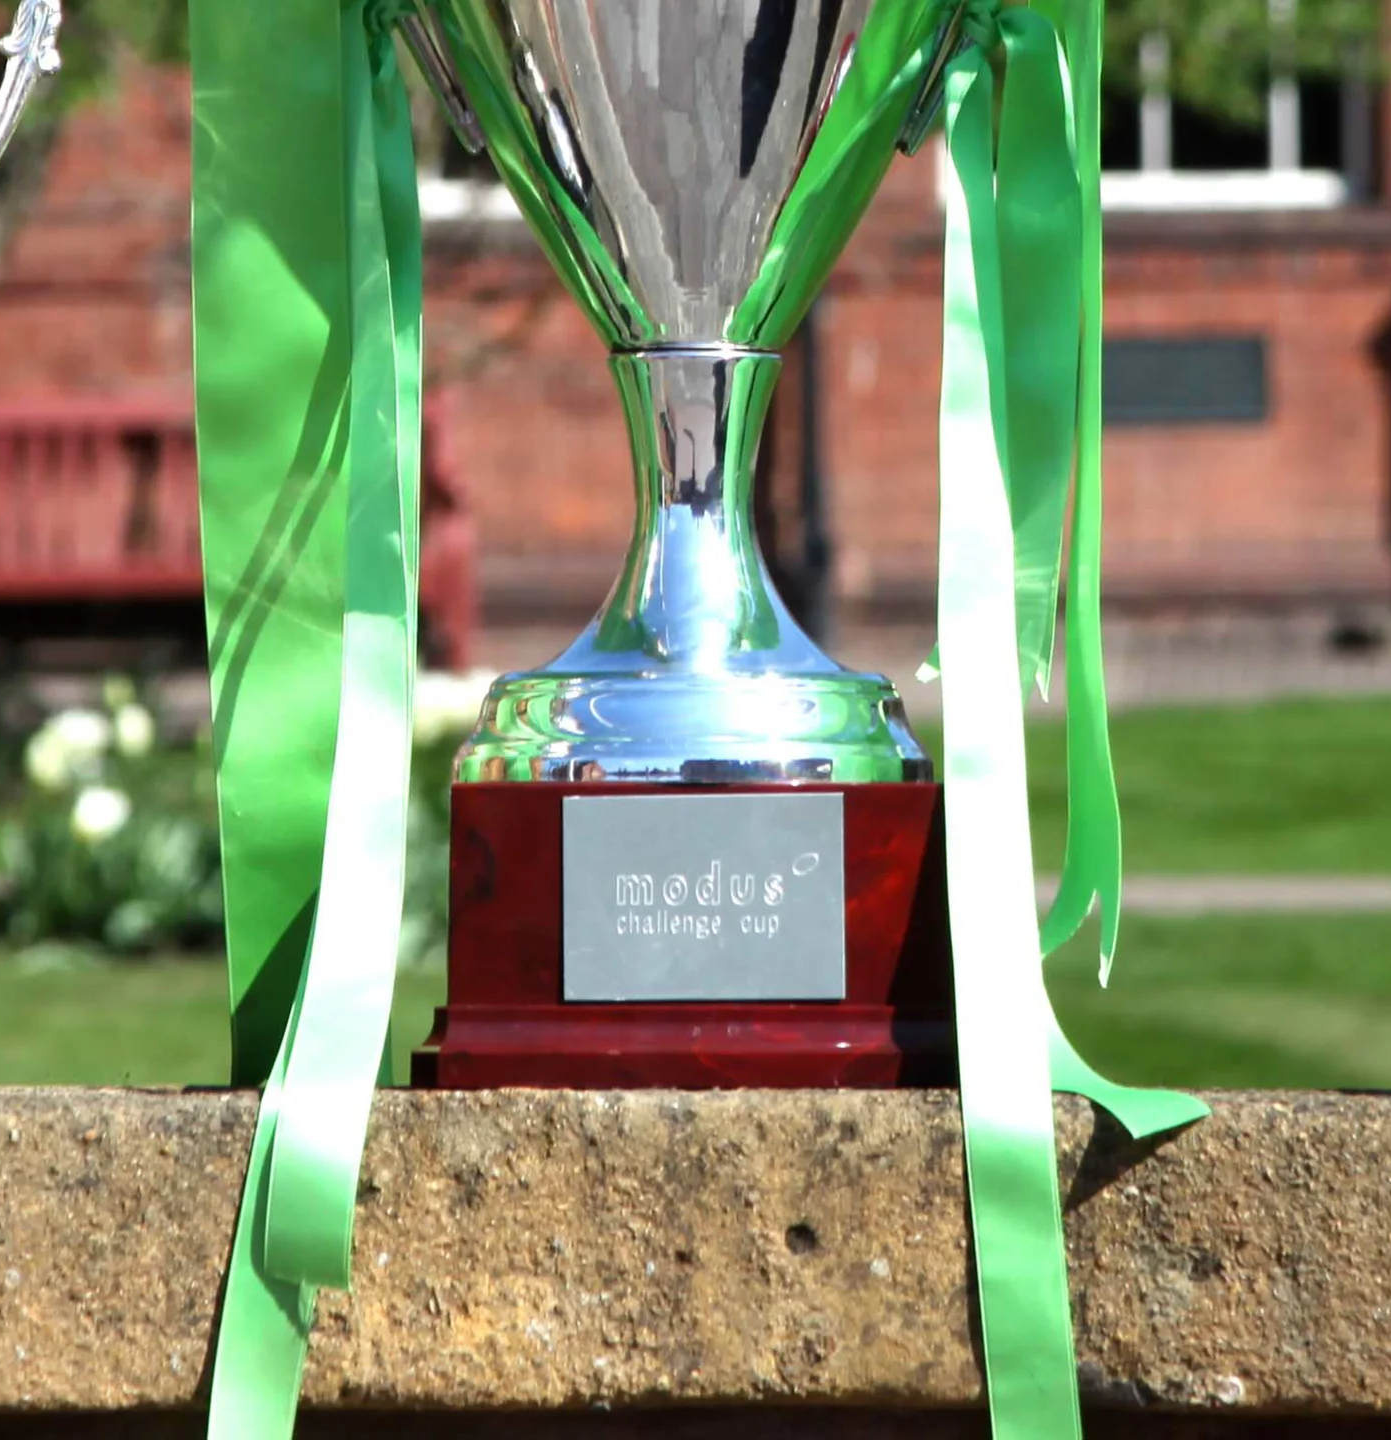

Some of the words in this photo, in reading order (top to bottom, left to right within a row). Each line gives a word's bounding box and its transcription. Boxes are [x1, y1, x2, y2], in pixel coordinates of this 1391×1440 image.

[615, 859, 785, 906] modus
[616, 910, 722, 939] challenge
[740, 914, 780, 939] cup
